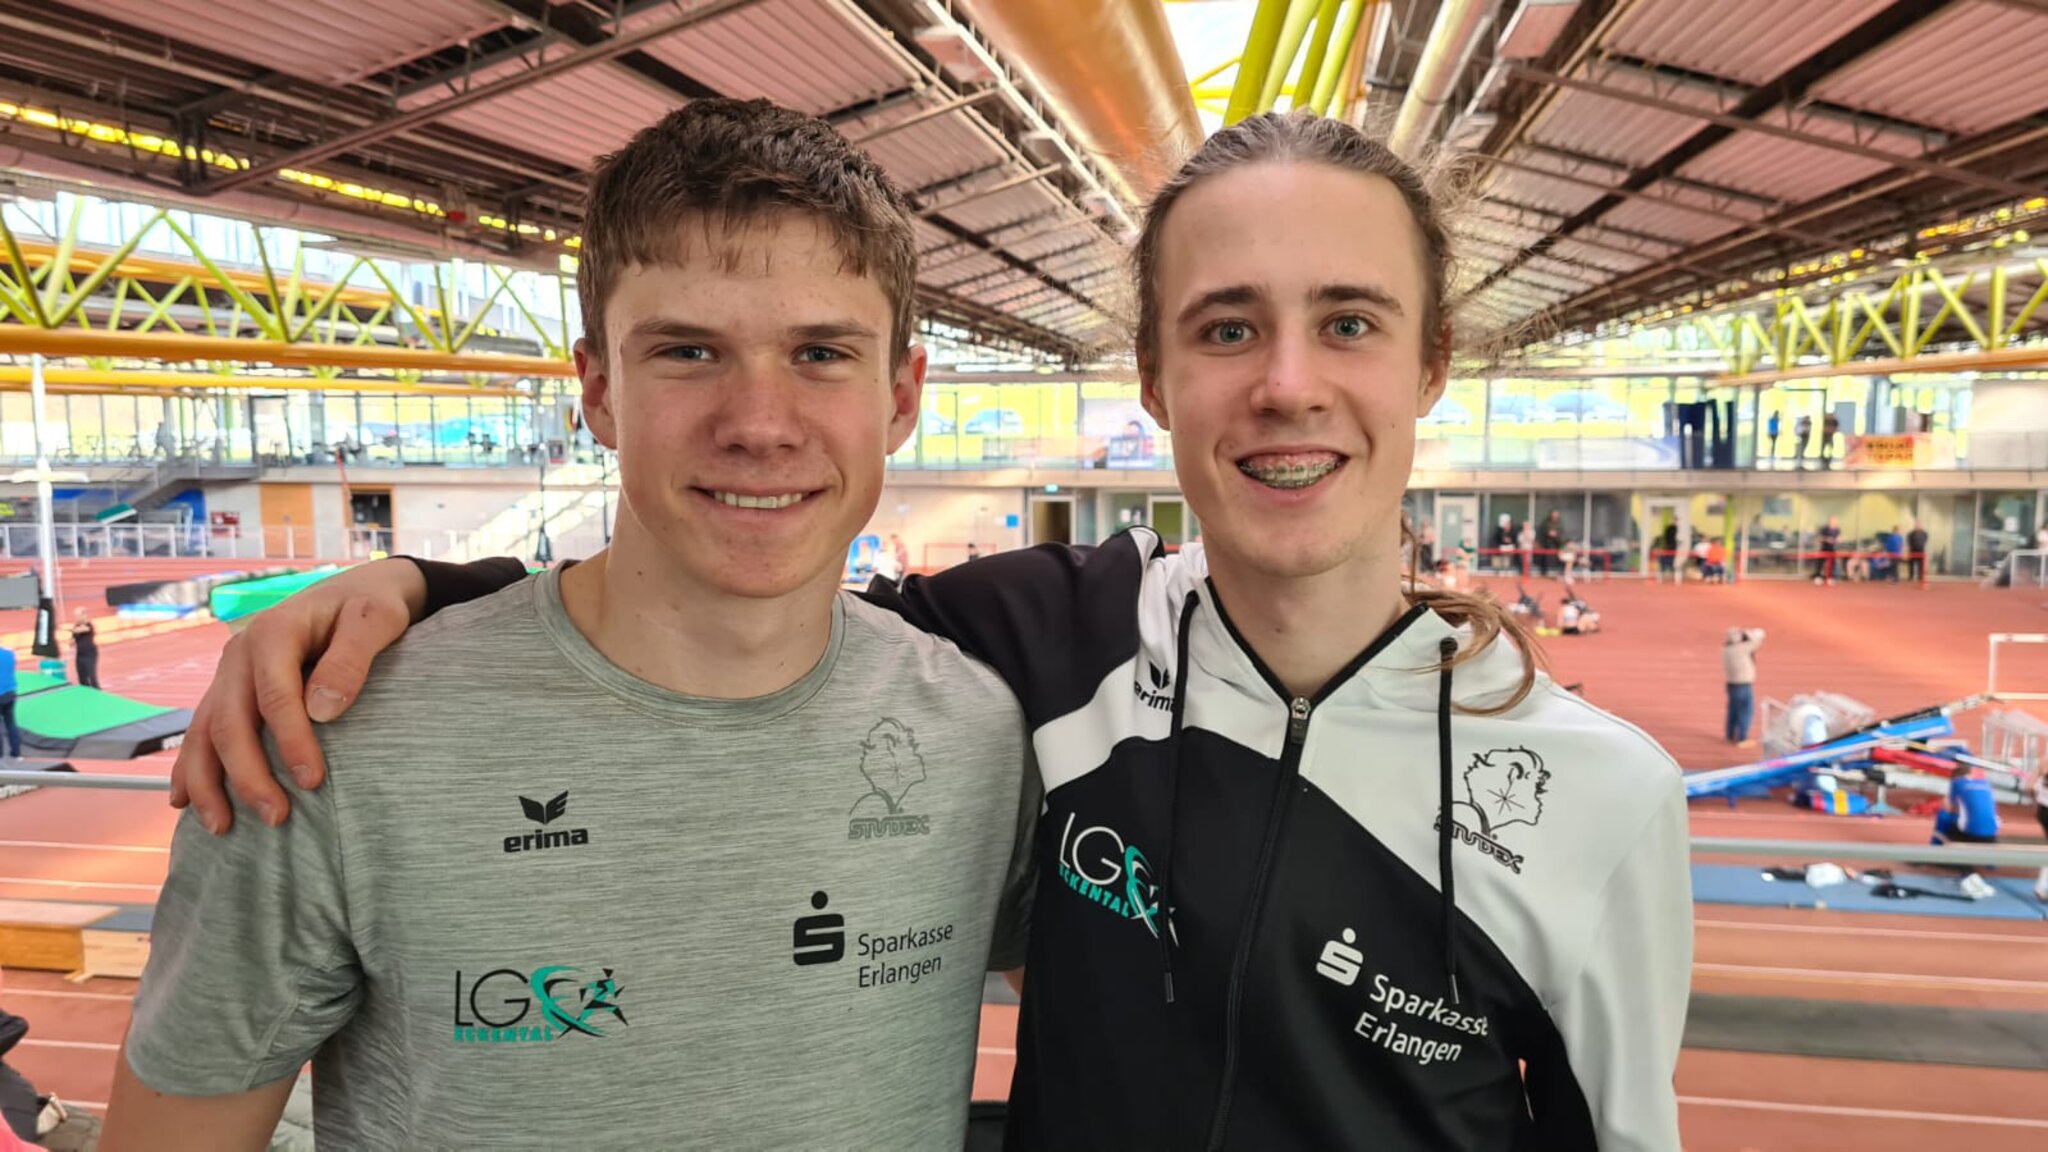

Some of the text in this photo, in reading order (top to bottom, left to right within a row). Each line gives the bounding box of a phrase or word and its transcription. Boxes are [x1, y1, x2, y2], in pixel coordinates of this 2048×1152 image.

[504, 829, 588, 853] erima
[848, 815, 930, 840] STUDEX
[858, 924, 953, 961] Sparkasse
[859, 956, 942, 988] Erlangen
[1354, 1011, 1463, 1065] Erlangen
